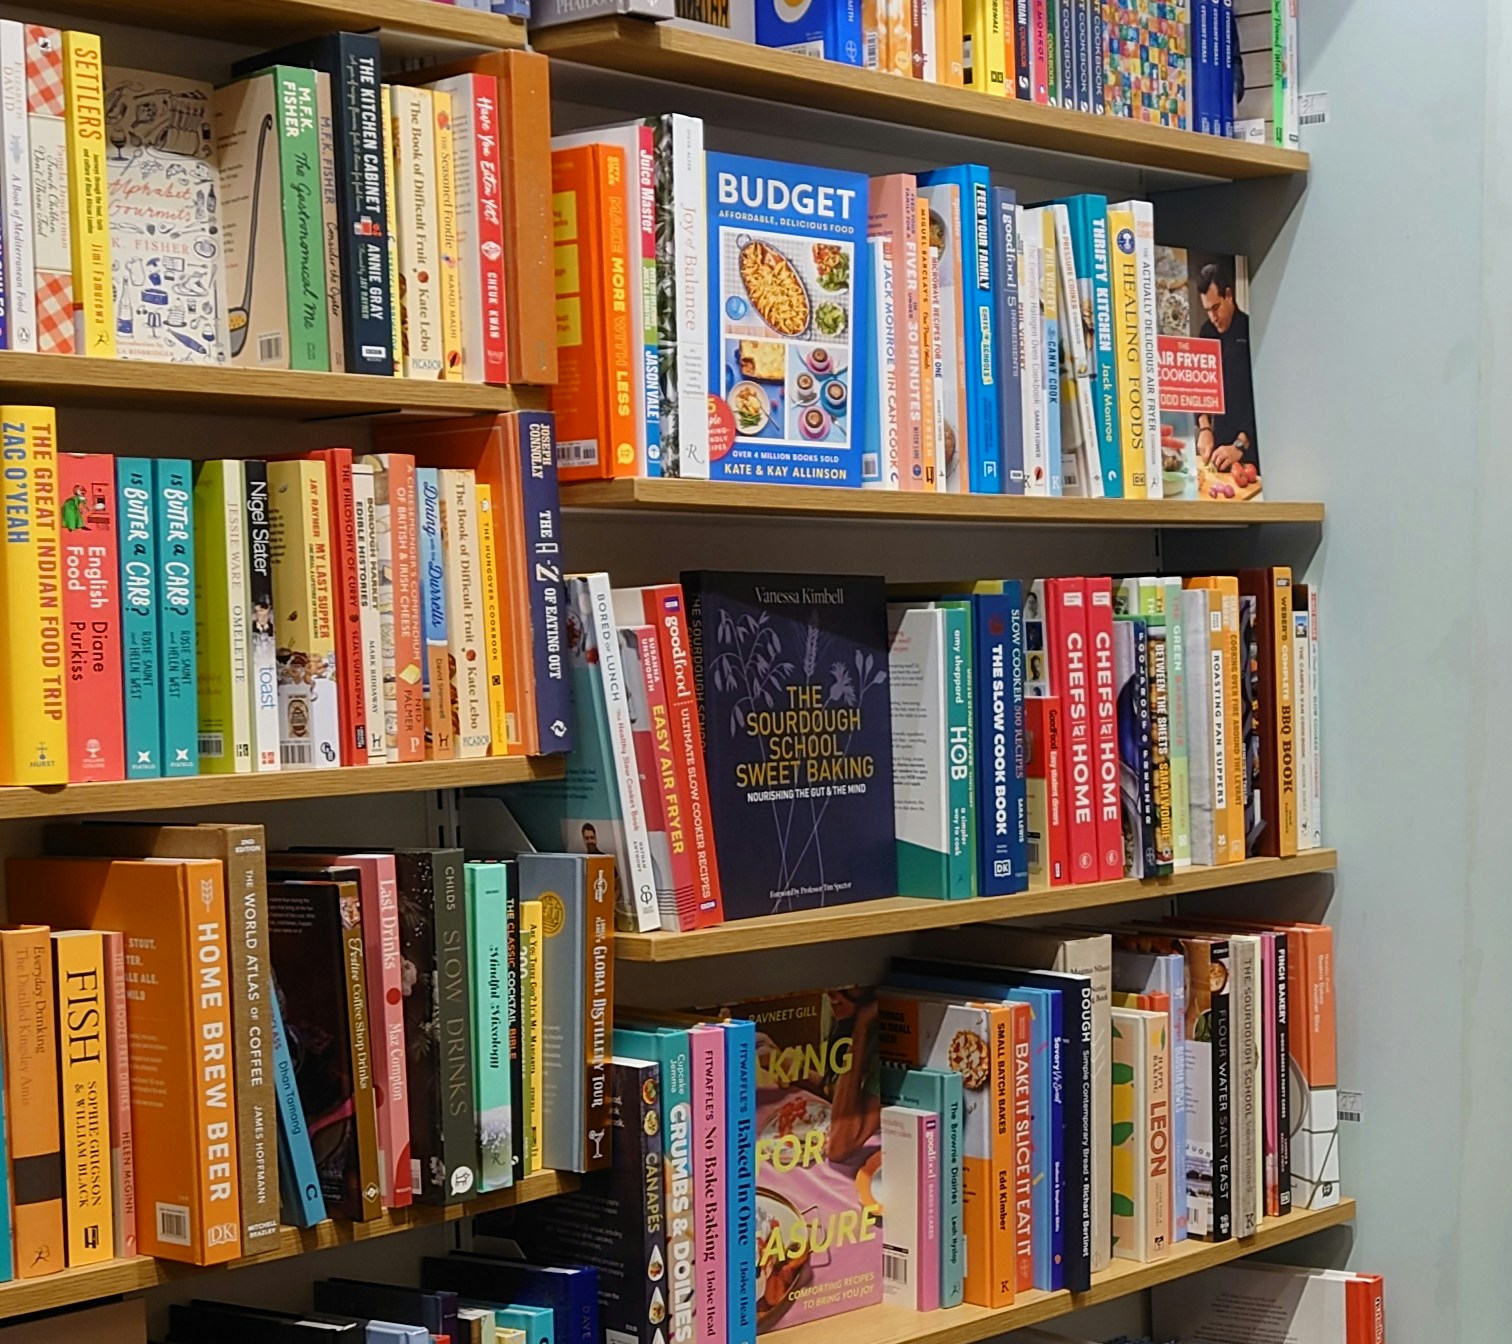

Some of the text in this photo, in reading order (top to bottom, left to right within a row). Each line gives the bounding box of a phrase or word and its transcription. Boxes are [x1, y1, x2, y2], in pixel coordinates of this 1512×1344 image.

[74, 47, 102, 141] SETTLERS
[718, 172, 856, 219] BUDGET
[719, 210, 854, 234] AFFORDABLE, DELICIOUS FOOD
[2, 423, 22, 463] ZAC
[725, 463, 752, 477] KATE
[767, 466, 789, 477] KAY
[792, 466, 847, 479] ALLINSON
[32, 424, 61, 721] THE GREAT INDIAN FOOD TRIP
[67, 545, 85, 591] Food
[88, 546, 107, 609] English
[755, 587, 844, 604] Vanessa Kimbell
[787, 686, 822, 709] THE
[747, 710, 861, 735] SOURDOUGH
[1068, 632, 1090, 825] CHEFS AT HOME
[769, 735, 843, 759] SCHOOL
[951, 727, 967, 780] HOB
[736, 756, 874, 788] SWEET BAKING
[747, 788, 793, 802] NOURISHING
[795, 787, 810, 799] THE
[812, 787, 826, 798] GUT
[834, 785, 846, 796] THE
[848, 784, 866, 795] MIND
[65, 968, 99, 1068] FISH
[199, 922, 230, 1203] HOME BREW BEER
[669, 1104, 692, 1344] CRUMBS & DOILIES
